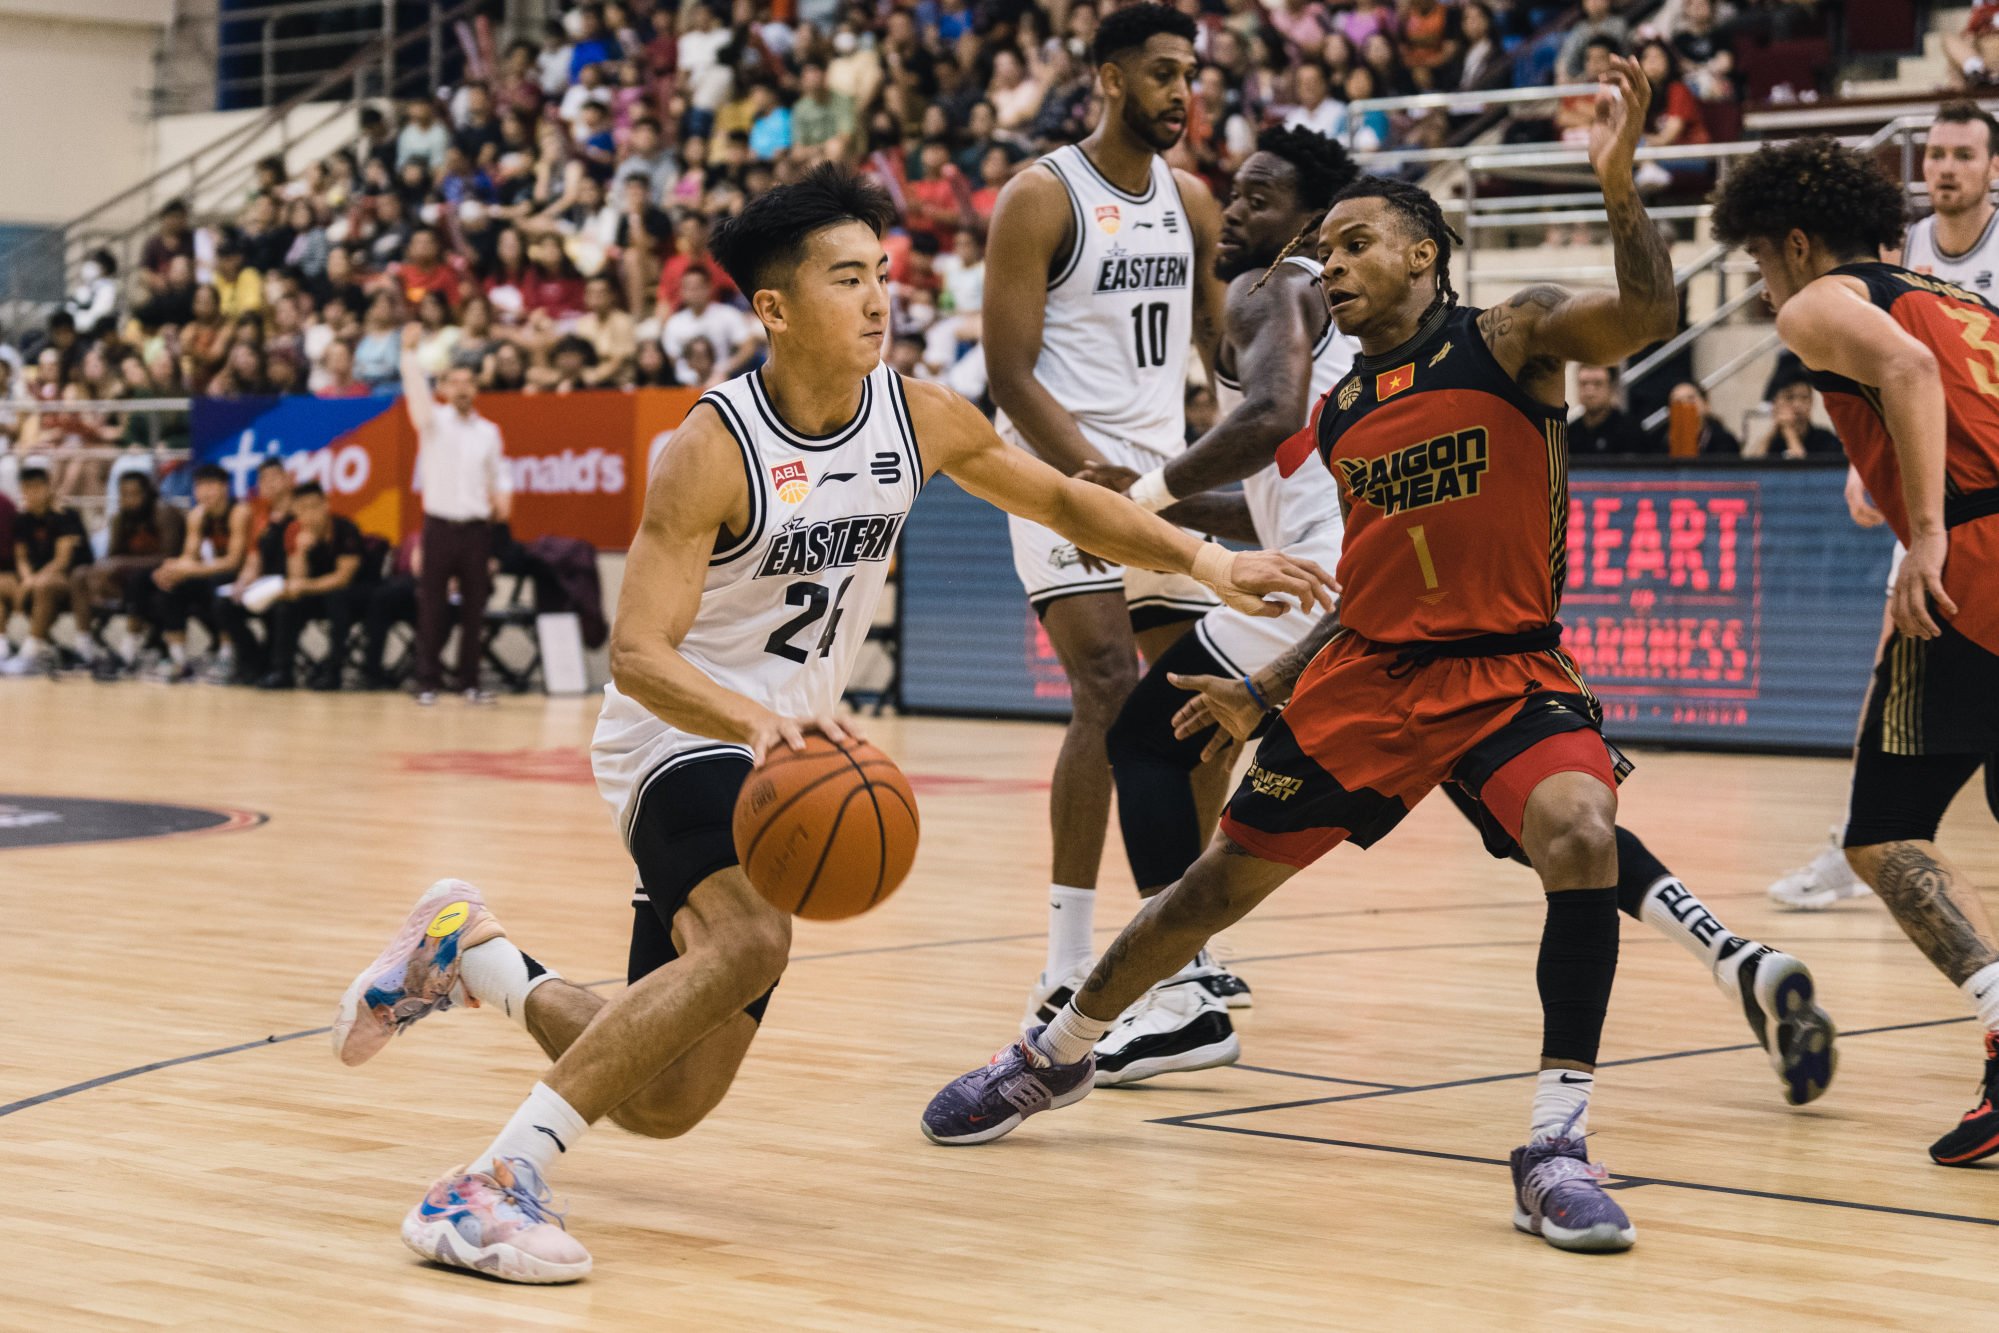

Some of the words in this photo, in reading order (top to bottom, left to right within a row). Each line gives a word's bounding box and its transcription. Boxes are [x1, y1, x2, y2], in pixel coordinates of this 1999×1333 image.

[1093, 253, 1188, 294] EASTERN
[1131, 302, 1169, 367] 10
[218, 428, 371, 497] tmo
[774, 463, 807, 485] ABL
[1347, 426, 1488, 498] SAIGON
[1372, 460, 1488, 518] HEAT
[753, 512, 905, 580] EASTERN
[1407, 525, 1438, 589] 1
[764, 575, 855, 664] 24
[1247, 763, 1304, 791] SAIGON
